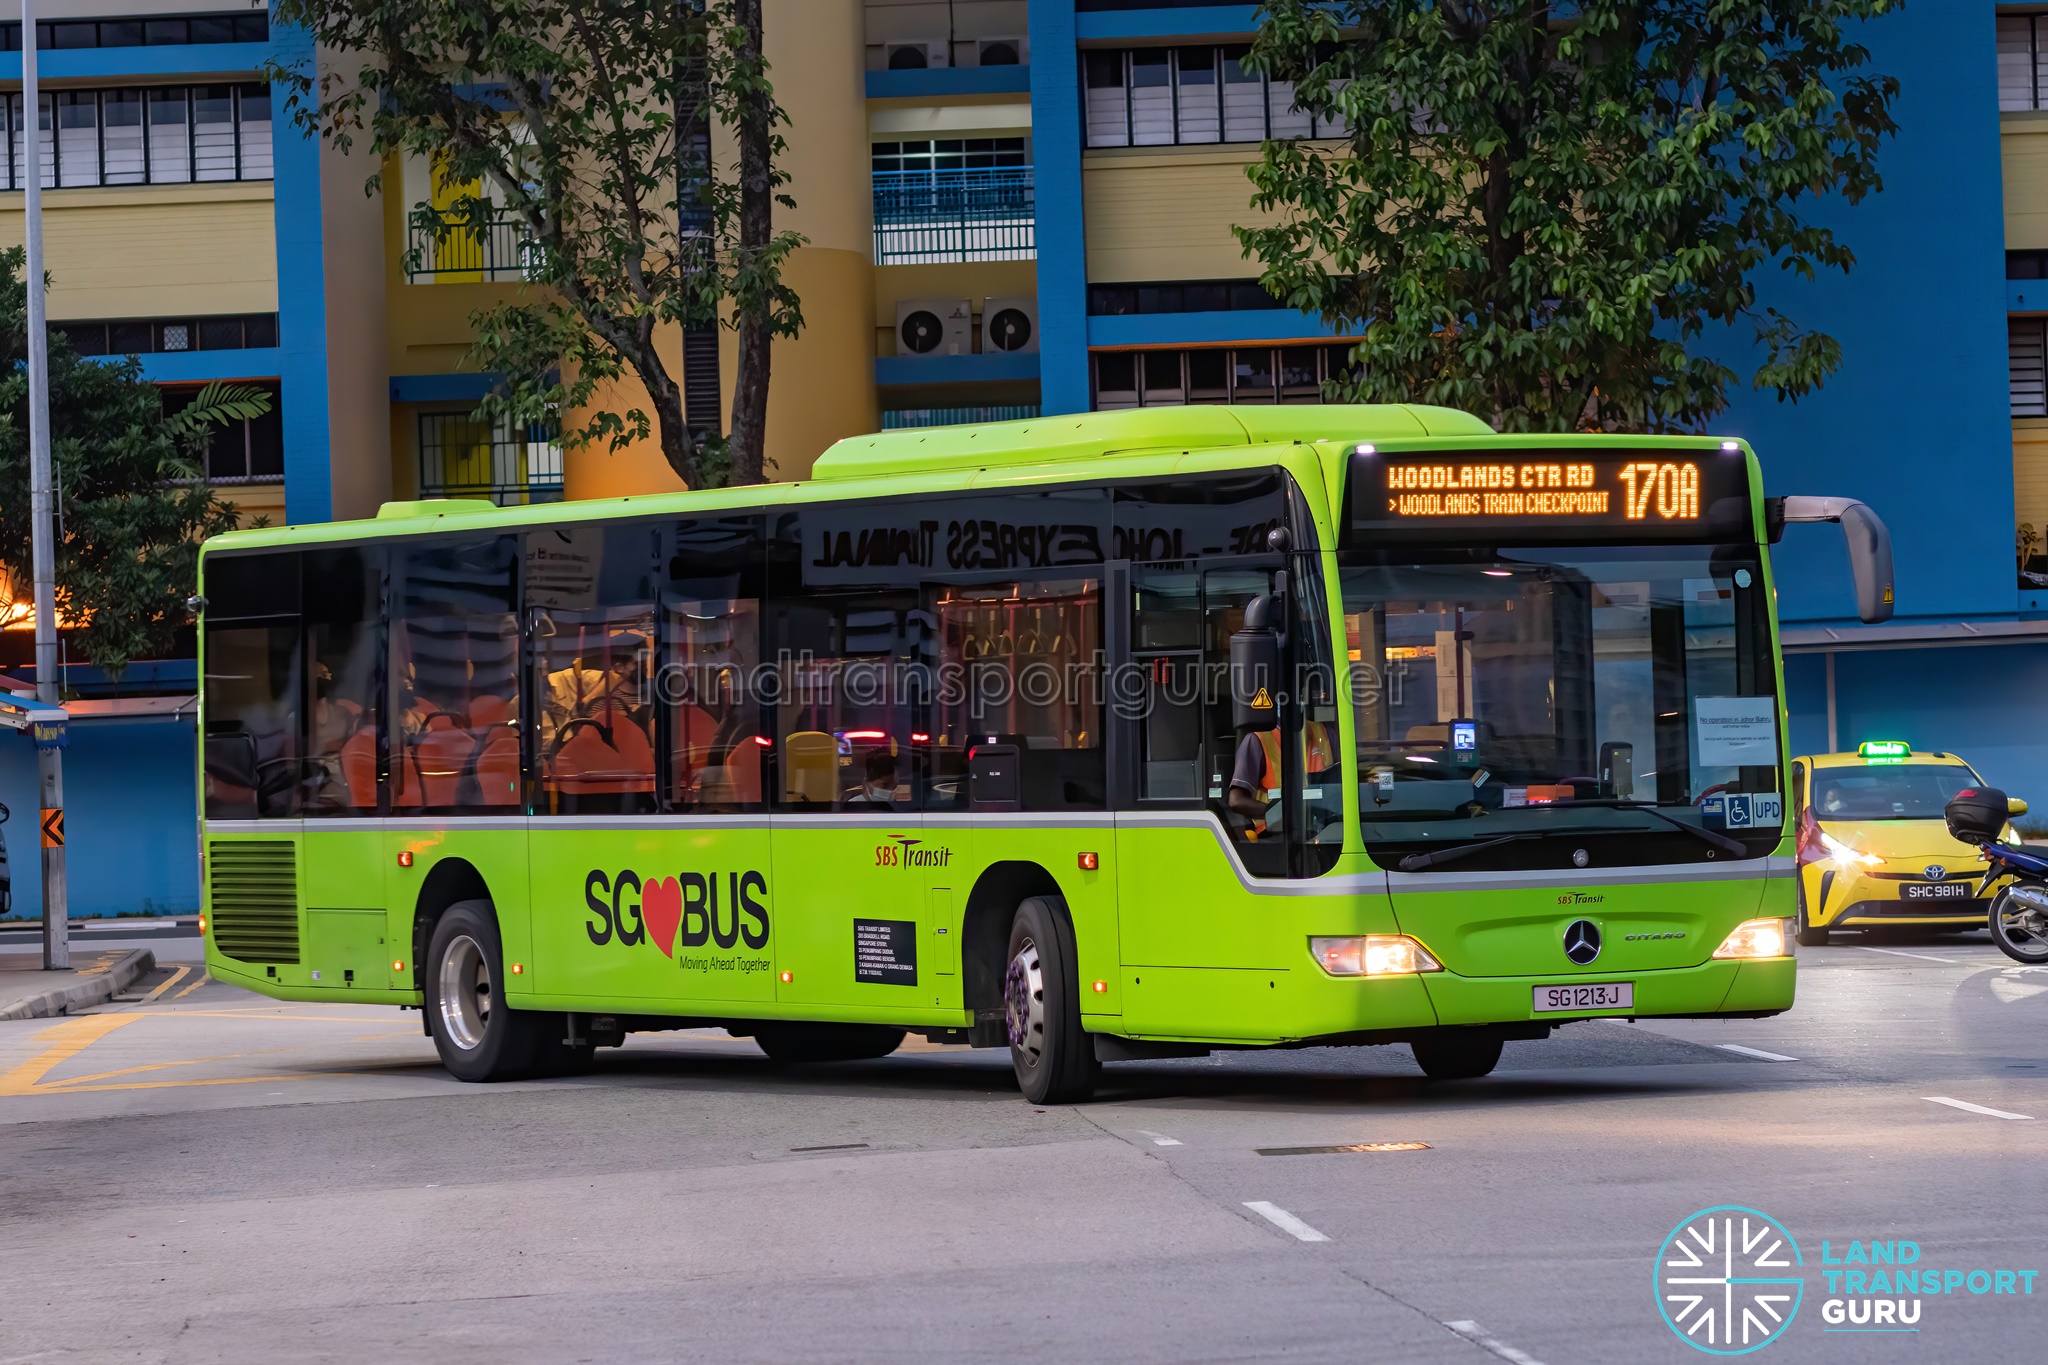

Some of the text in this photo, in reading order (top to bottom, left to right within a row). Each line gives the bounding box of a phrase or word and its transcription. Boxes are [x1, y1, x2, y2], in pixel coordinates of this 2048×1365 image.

[1389, 464, 1595, 488] WOODLANDS CTR RD
[1618, 463, 1699, 518] 170A
[1399, 491, 1609, 515] WOODLANDS TRAIN CHECKPOINT
[1755, 801, 1780, 819] UPD
[876, 839, 954, 871] SBS Transit
[585, 869, 770, 950] SG BUS
[1557, 892, 1606, 905] SBS Transit
[1625, 932, 1686, 941] CITARO
[680, 956, 770, 975] Moving Ahead Together
[1548, 986, 1619, 1006] SG1213J
